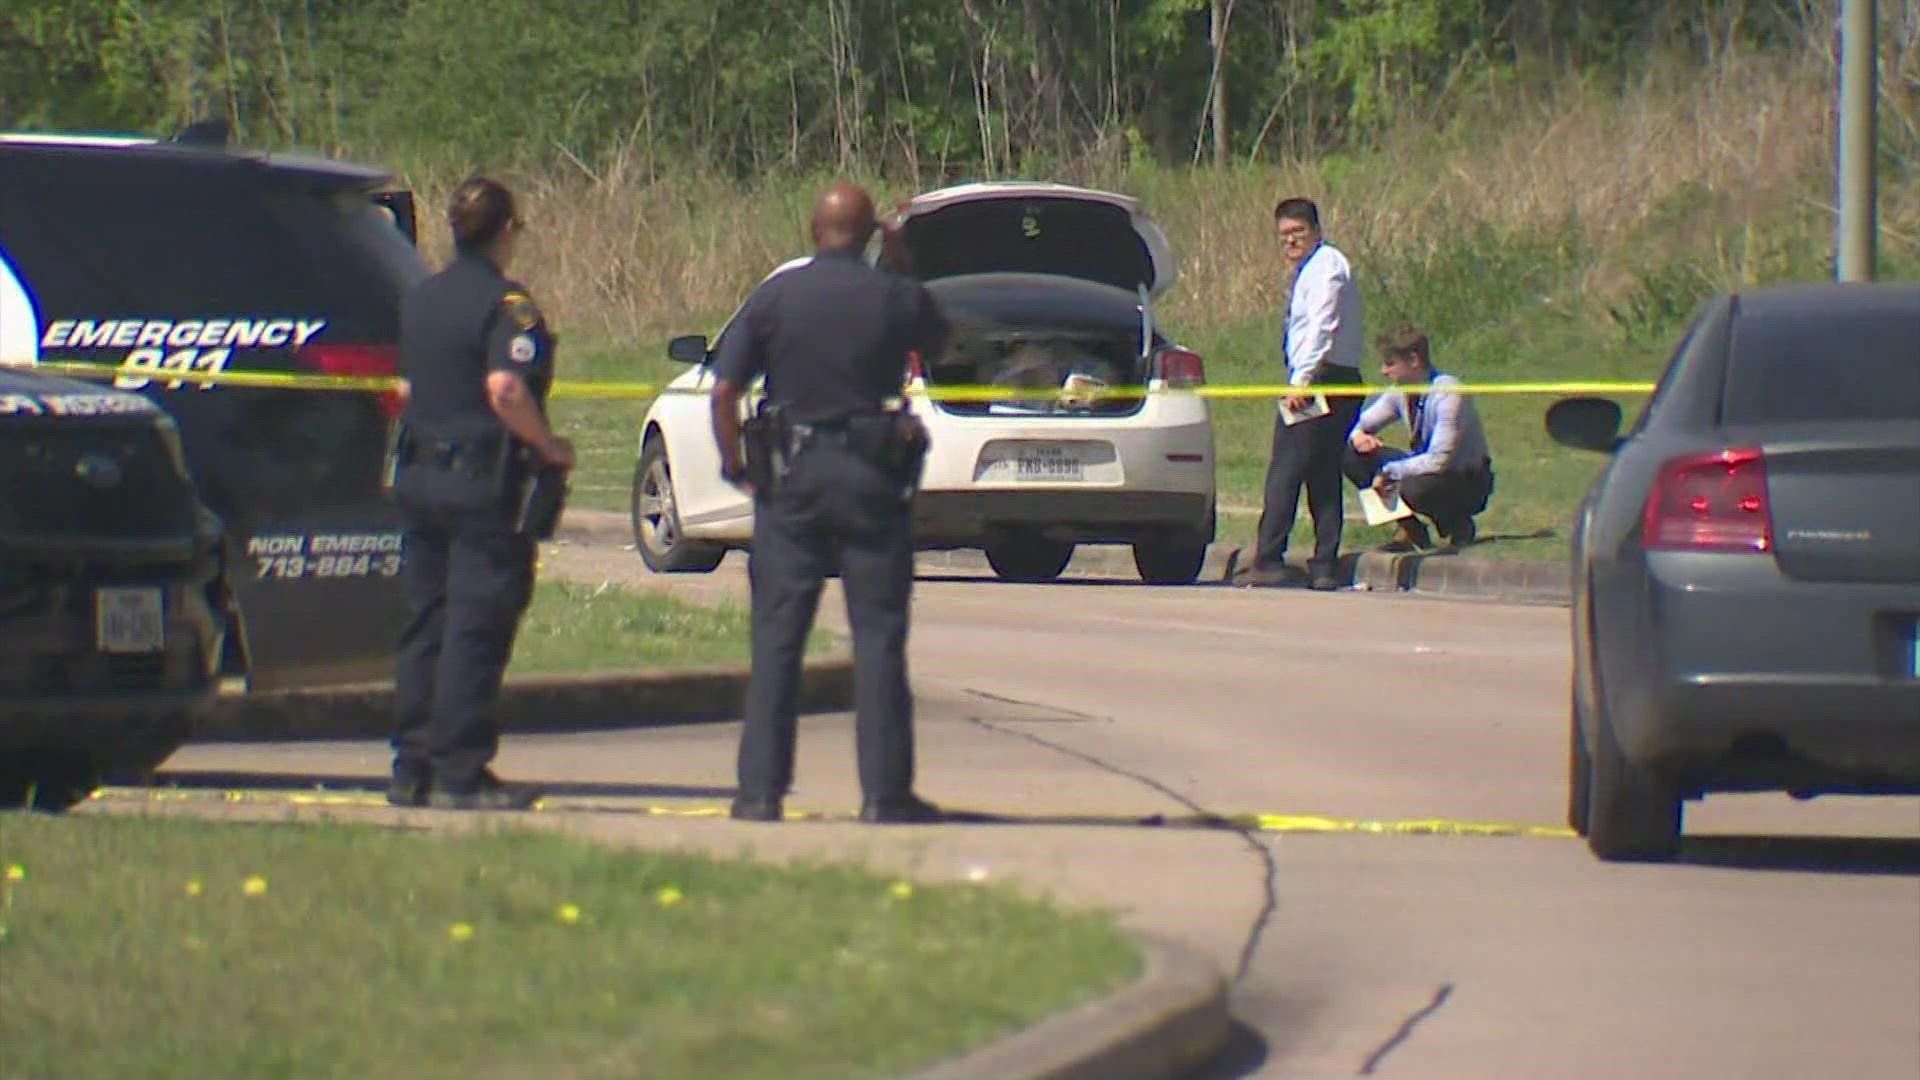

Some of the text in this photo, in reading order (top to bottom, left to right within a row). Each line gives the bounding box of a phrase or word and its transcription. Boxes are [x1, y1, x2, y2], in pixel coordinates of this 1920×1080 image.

[41, 320, 327, 347] EMERGENCY
[114, 347, 233, 390] 911
[248, 535, 304, 553] NON
